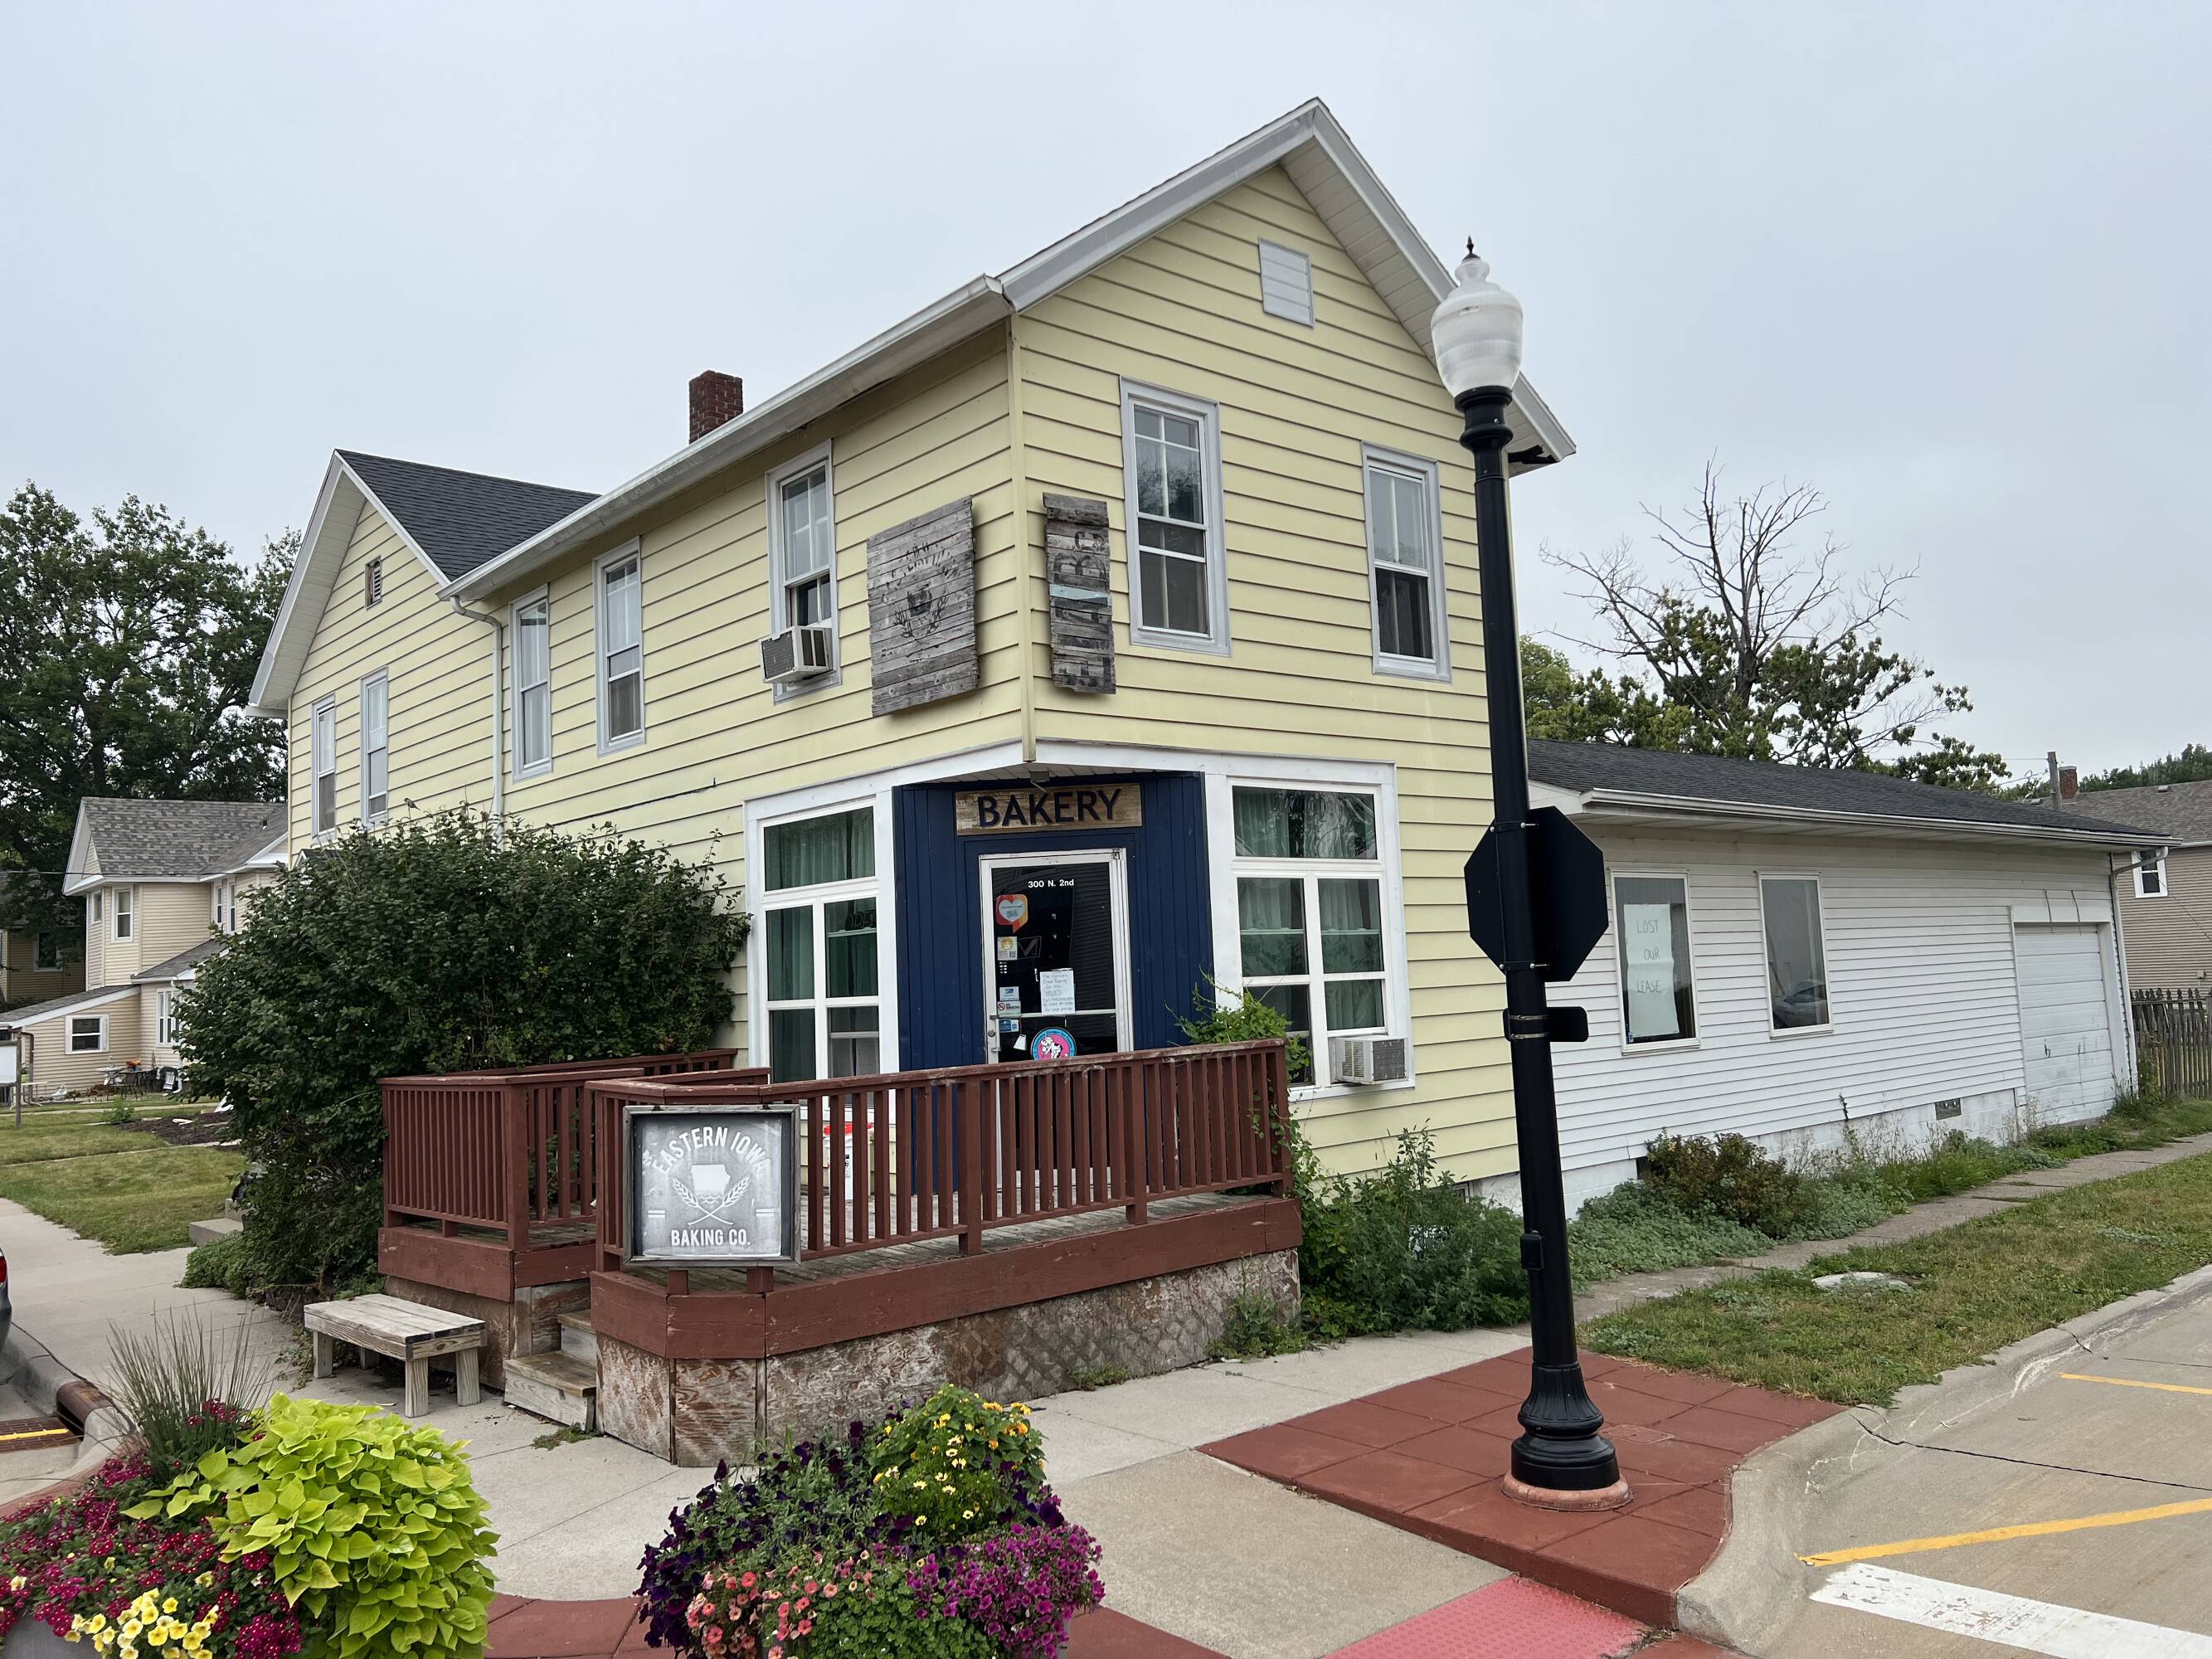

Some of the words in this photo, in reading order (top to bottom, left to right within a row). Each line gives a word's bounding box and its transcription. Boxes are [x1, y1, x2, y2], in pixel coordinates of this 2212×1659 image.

[977, 788, 1121, 828] BAKERY
[1028, 880, 1045, 888] 300
[1059, 878, 1074, 887] 2nd
[1636, 920, 1660, 934] LOST
[1643, 947, 1660, 961] OUR
[1636, 979, 1660, 994] LEASE
[652, 1126, 728, 1175] EASTERN
[730, 1131, 772, 1175] IOWA
[671, 1228, 724, 1246] BAKING
[728, 1228, 751, 1245] CO.
